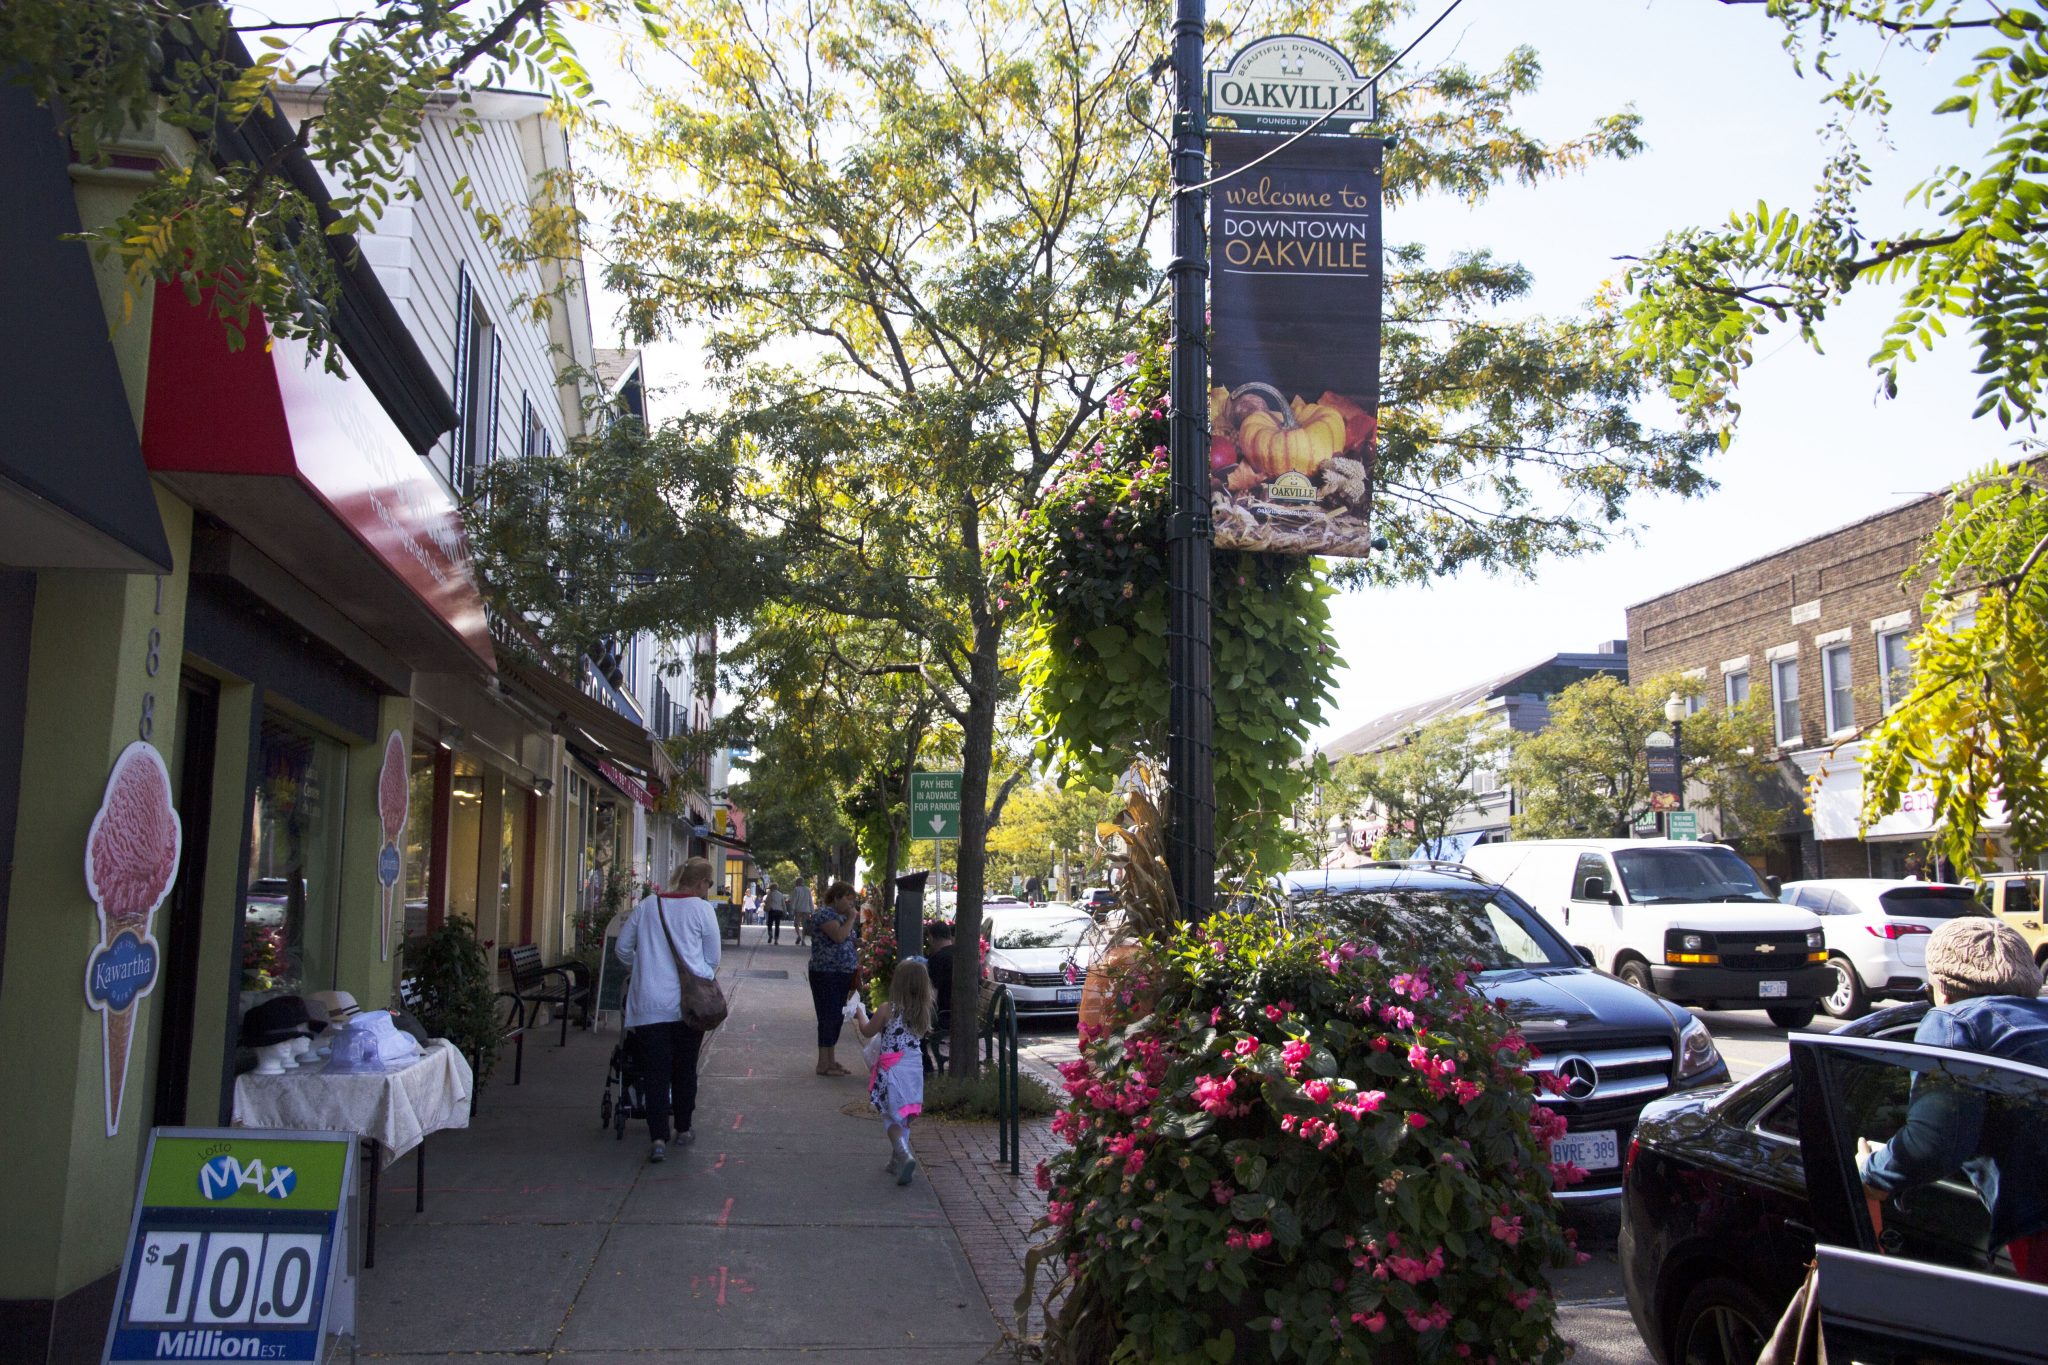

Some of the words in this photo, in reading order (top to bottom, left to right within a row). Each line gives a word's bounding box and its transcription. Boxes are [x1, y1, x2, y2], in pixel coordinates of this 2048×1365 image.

[1238, 44, 1287, 77] BEAUTIFUL
[1292, 44, 1347, 81] DOWNTOWN
[1220, 81, 1365, 112] OAKVILLE
[1256, 117, 1298, 126] FOUNDED
[1226, 176, 1332, 208] welcome
[1338, 184, 1367, 209] to
[1225, 218, 1366, 240] DOWNTOWN
[1225, 239, 1367, 268] OAKVILLE
[1271, 486, 1315, 498] OAKVILLE
[916, 791, 925, 800] IN
[925, 791, 958, 800] ADVANCE
[920, 780, 934, 789] PAY
[935, 780, 954, 789] HERE
[914, 802, 929, 811] FOR
[930, 802, 960, 811] PARKING
[95, 953, 151, 990] Kawartha
[1553, 1142, 1586, 1162] BVRE
[1593, 1141, 1615, 1160] 389
[200, 1156, 294, 1200] MAX
[156, 1330, 261, 1359] Million
[260, 1344, 286, 1358] EST.
